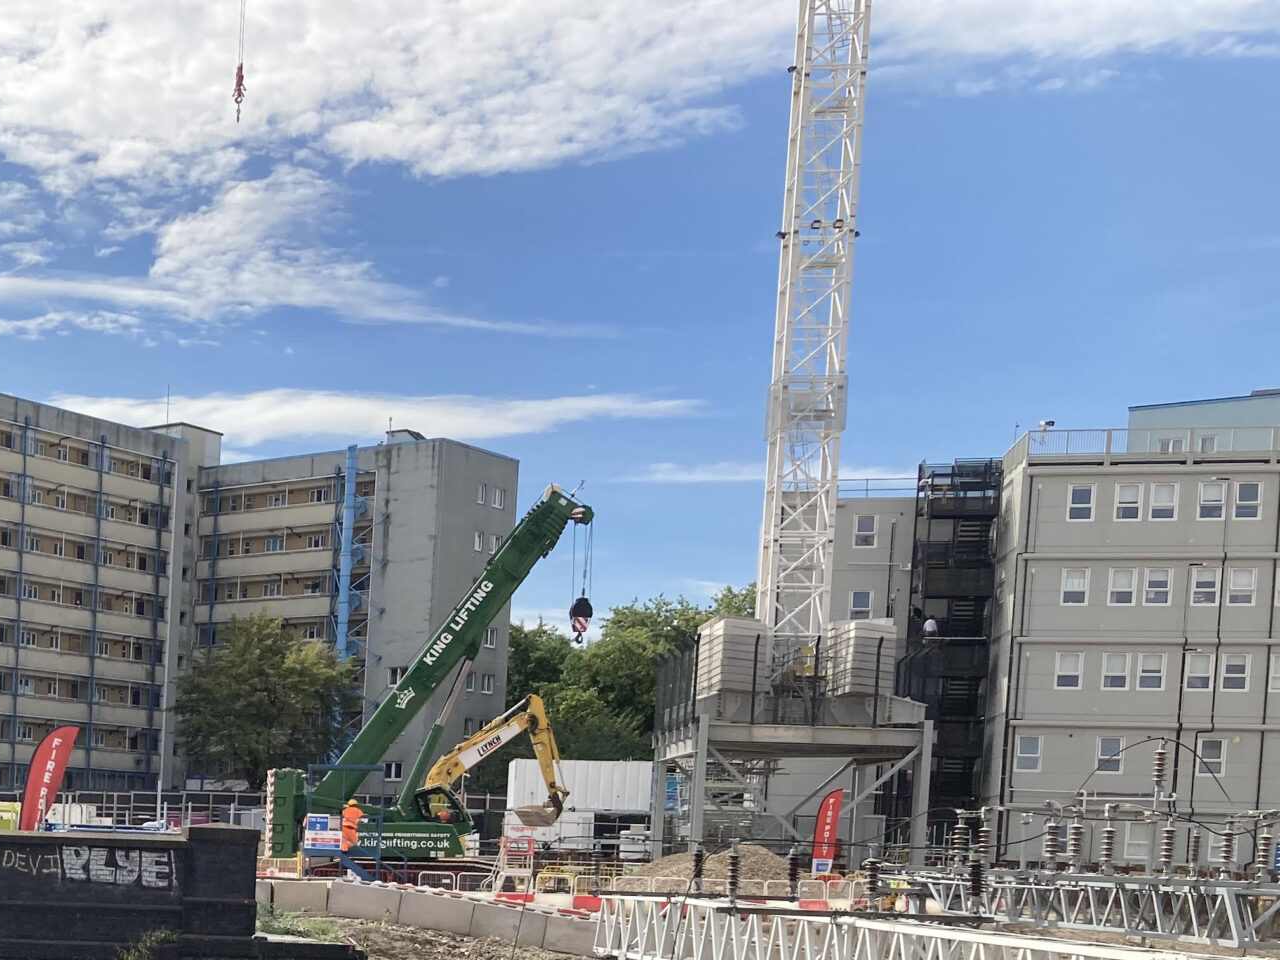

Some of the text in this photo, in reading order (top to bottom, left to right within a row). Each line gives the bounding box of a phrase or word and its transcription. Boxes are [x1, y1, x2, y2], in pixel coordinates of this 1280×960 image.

[423, 580, 495, 667] KING LIFTING
[43, 737, 63, 784] FIRE
